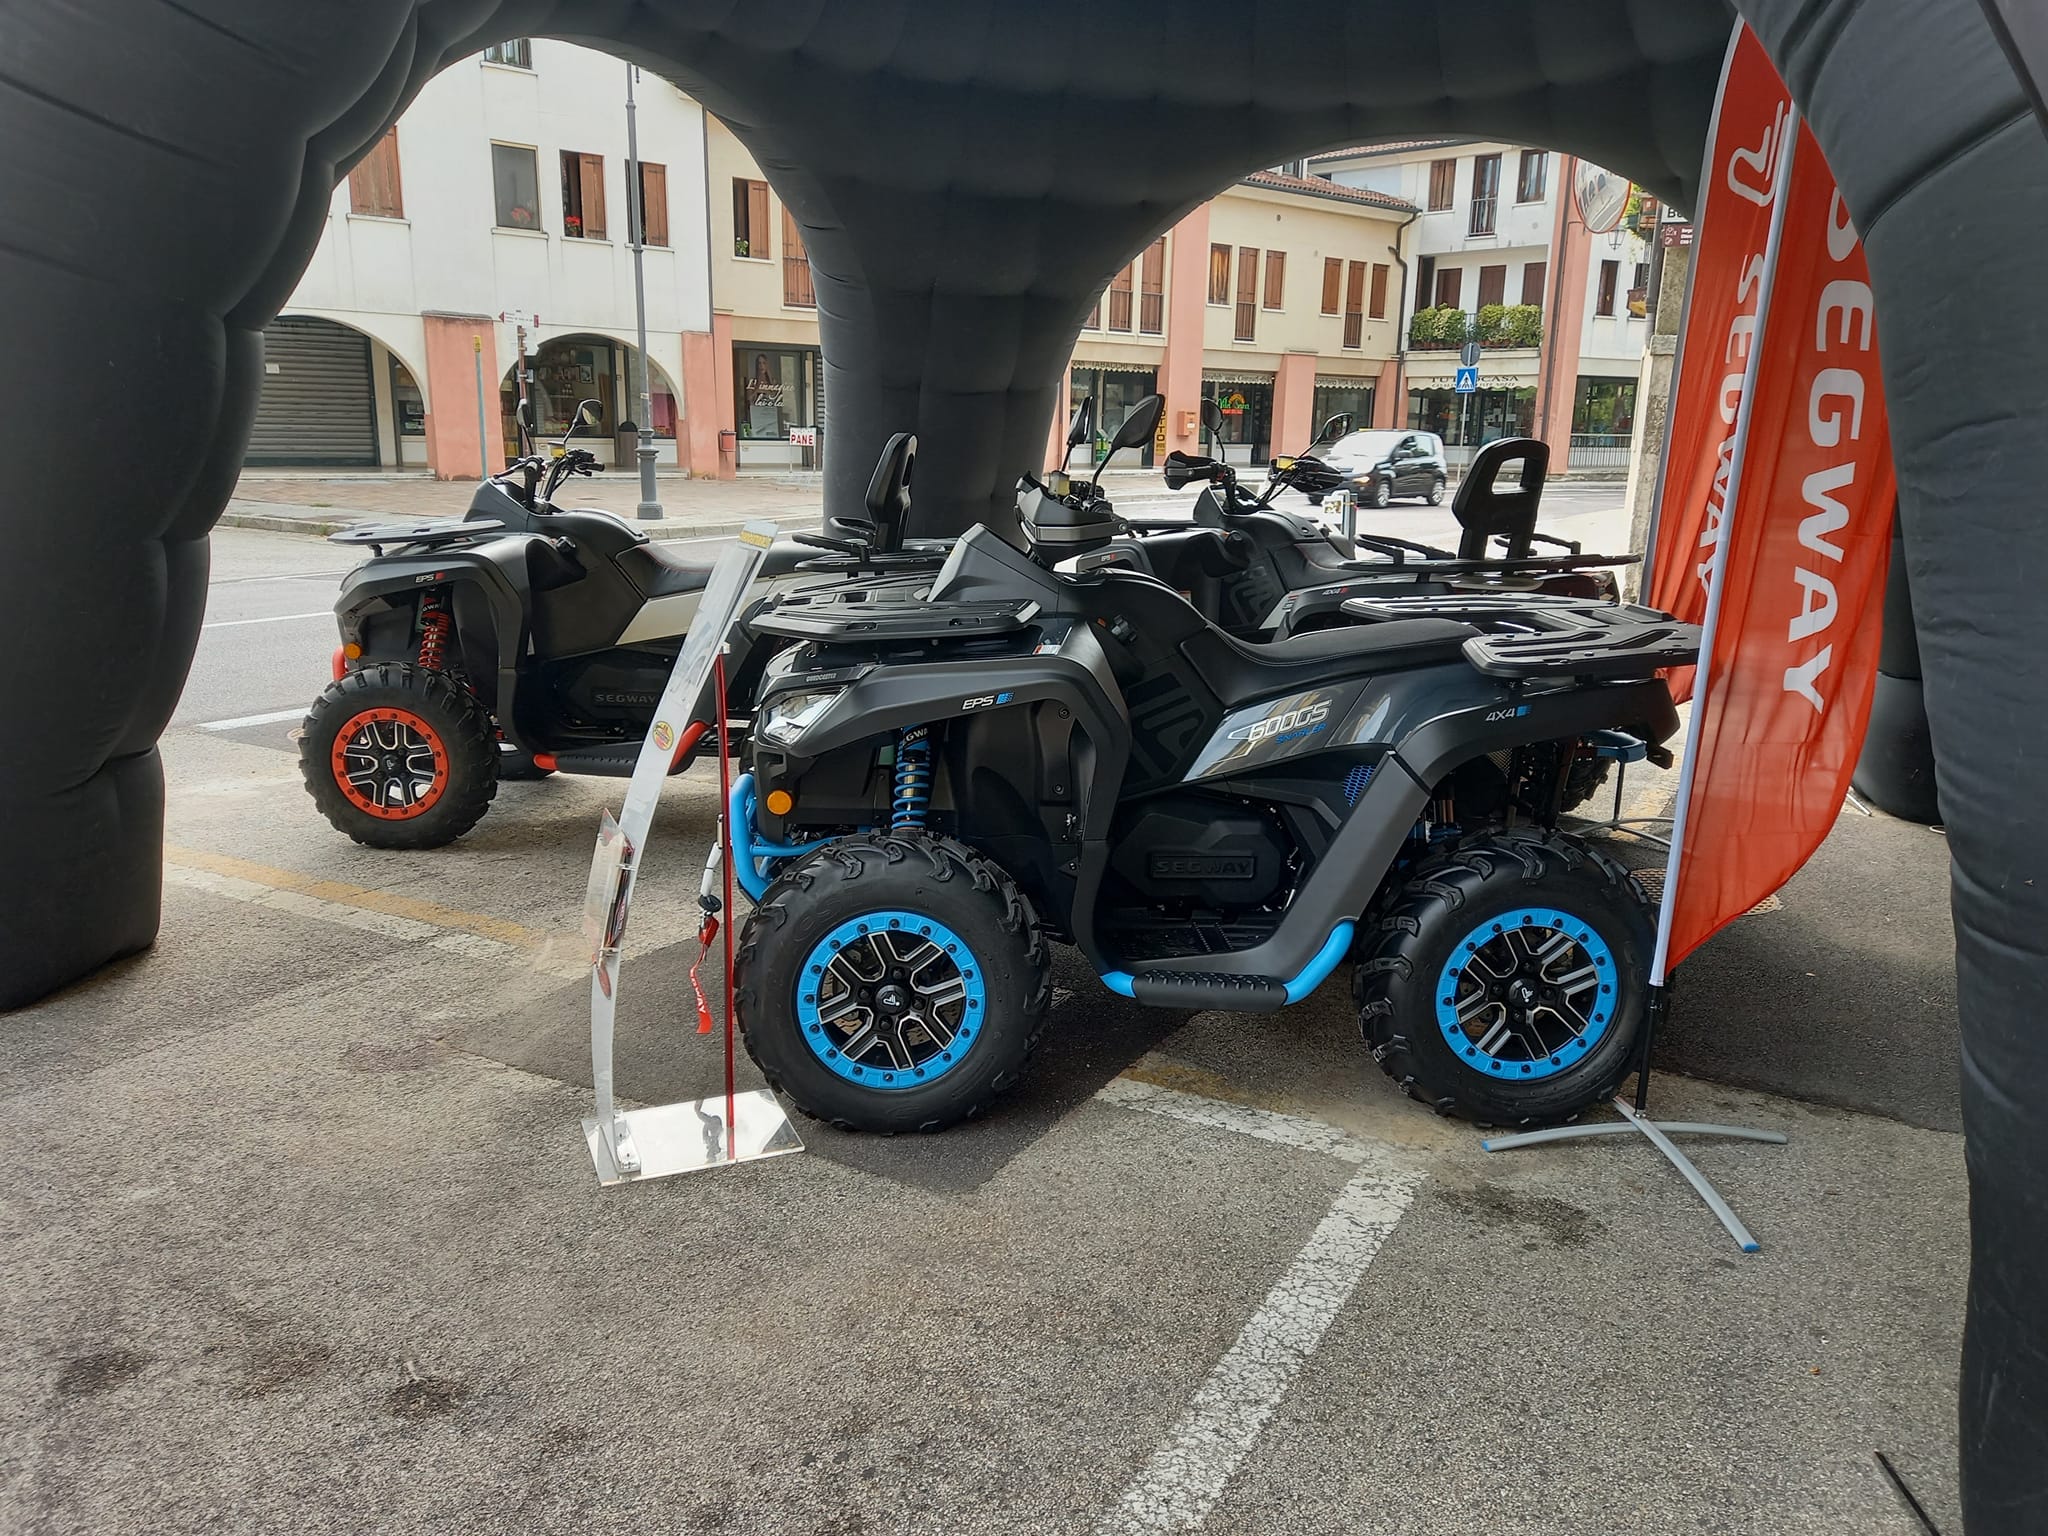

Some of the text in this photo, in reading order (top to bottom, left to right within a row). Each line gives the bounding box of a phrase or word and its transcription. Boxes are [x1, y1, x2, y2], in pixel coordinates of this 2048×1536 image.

[791, 434, 814, 445] PANE
[415, 573, 435, 583] EPS
[595, 694, 656, 704] SEGWAY
[962, 695, 995, 710] EPS
[1154, 861, 1249, 874] SEGWAY
